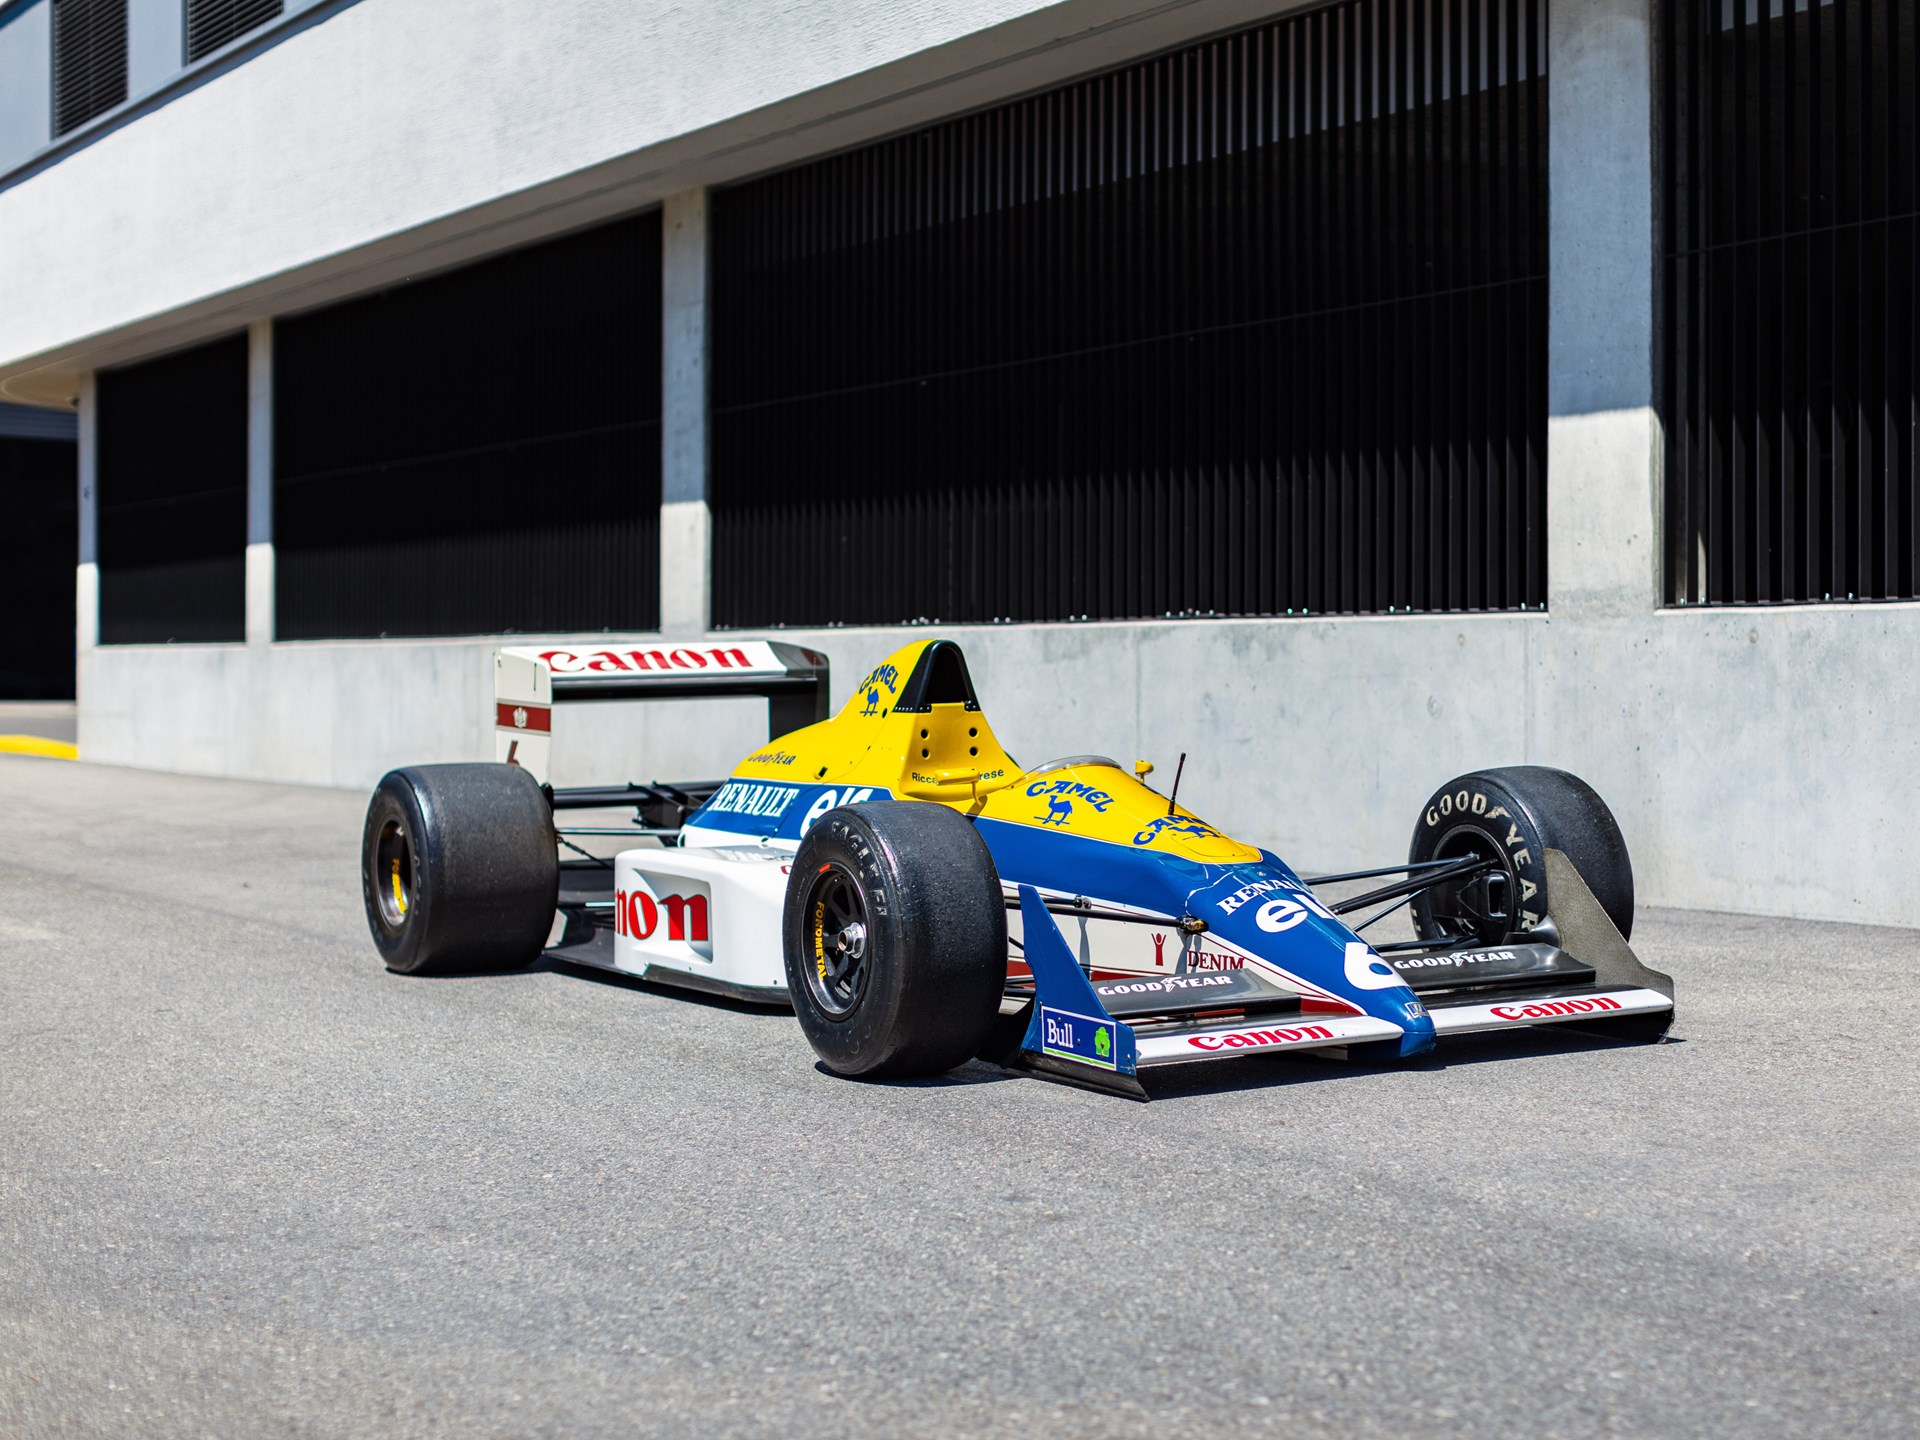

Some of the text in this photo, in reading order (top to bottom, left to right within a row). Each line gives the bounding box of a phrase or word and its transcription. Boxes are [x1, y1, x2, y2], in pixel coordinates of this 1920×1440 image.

[538, 648, 753, 673] Canon
[858, 664, 899, 695] CAMEL
[707, 783, 799, 819] RENAULT
[1026, 780, 1116, 813] CAMEL
[1426, 790, 1538, 934] GOODYEAR
[1216, 879, 1301, 916] RENA
[617, 887, 709, 941] non
[814, 901, 828, 982] FONOMETAL
[1187, 950, 1246, 970] DENIM
[1394, 951, 1517, 969] GOODYEAR
[1097, 974, 1233, 996] GOODYEAR
[1490, 997, 1622, 1020] Canon
[1047, 1018, 1074, 1049] Bull
[1188, 1025, 1334, 1050] Canon
